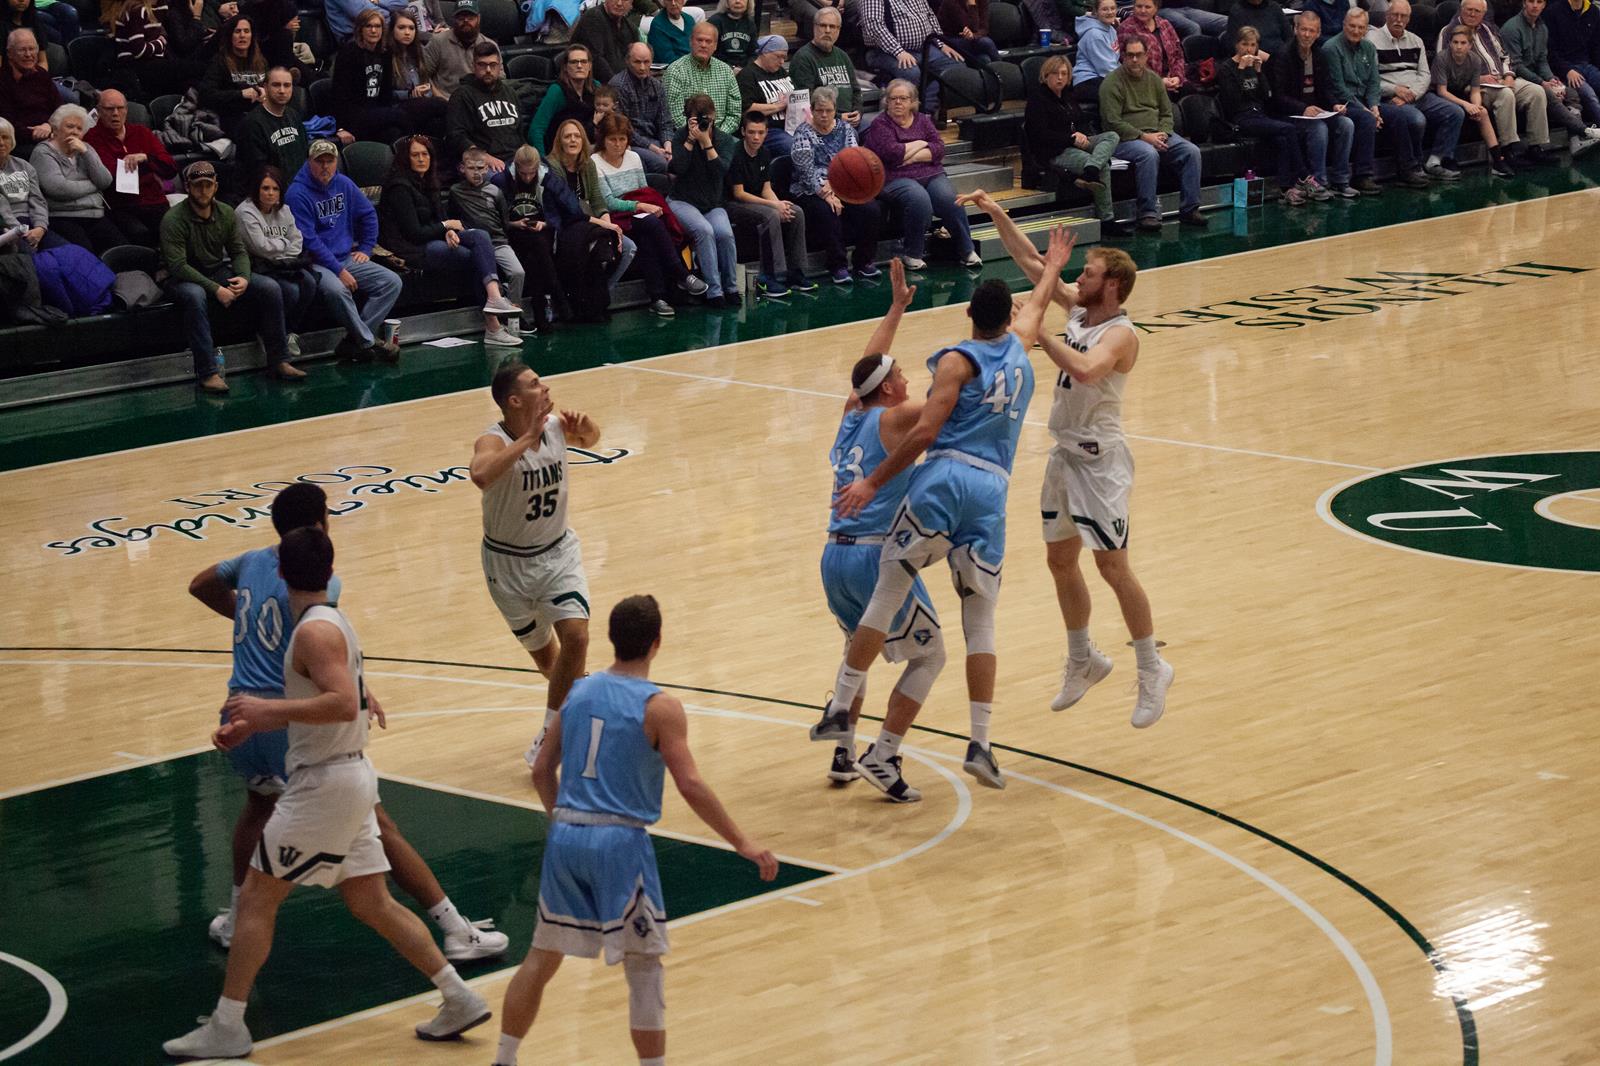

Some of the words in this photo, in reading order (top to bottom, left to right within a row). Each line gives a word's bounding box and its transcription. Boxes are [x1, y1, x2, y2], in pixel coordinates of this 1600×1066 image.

[477, 100, 518, 122] IWU
[979, 367, 1024, 421] 42
[521, 460, 564, 492] TITANS
[525, 488, 559, 521] 35
[581, 715, 605, 779] 1
